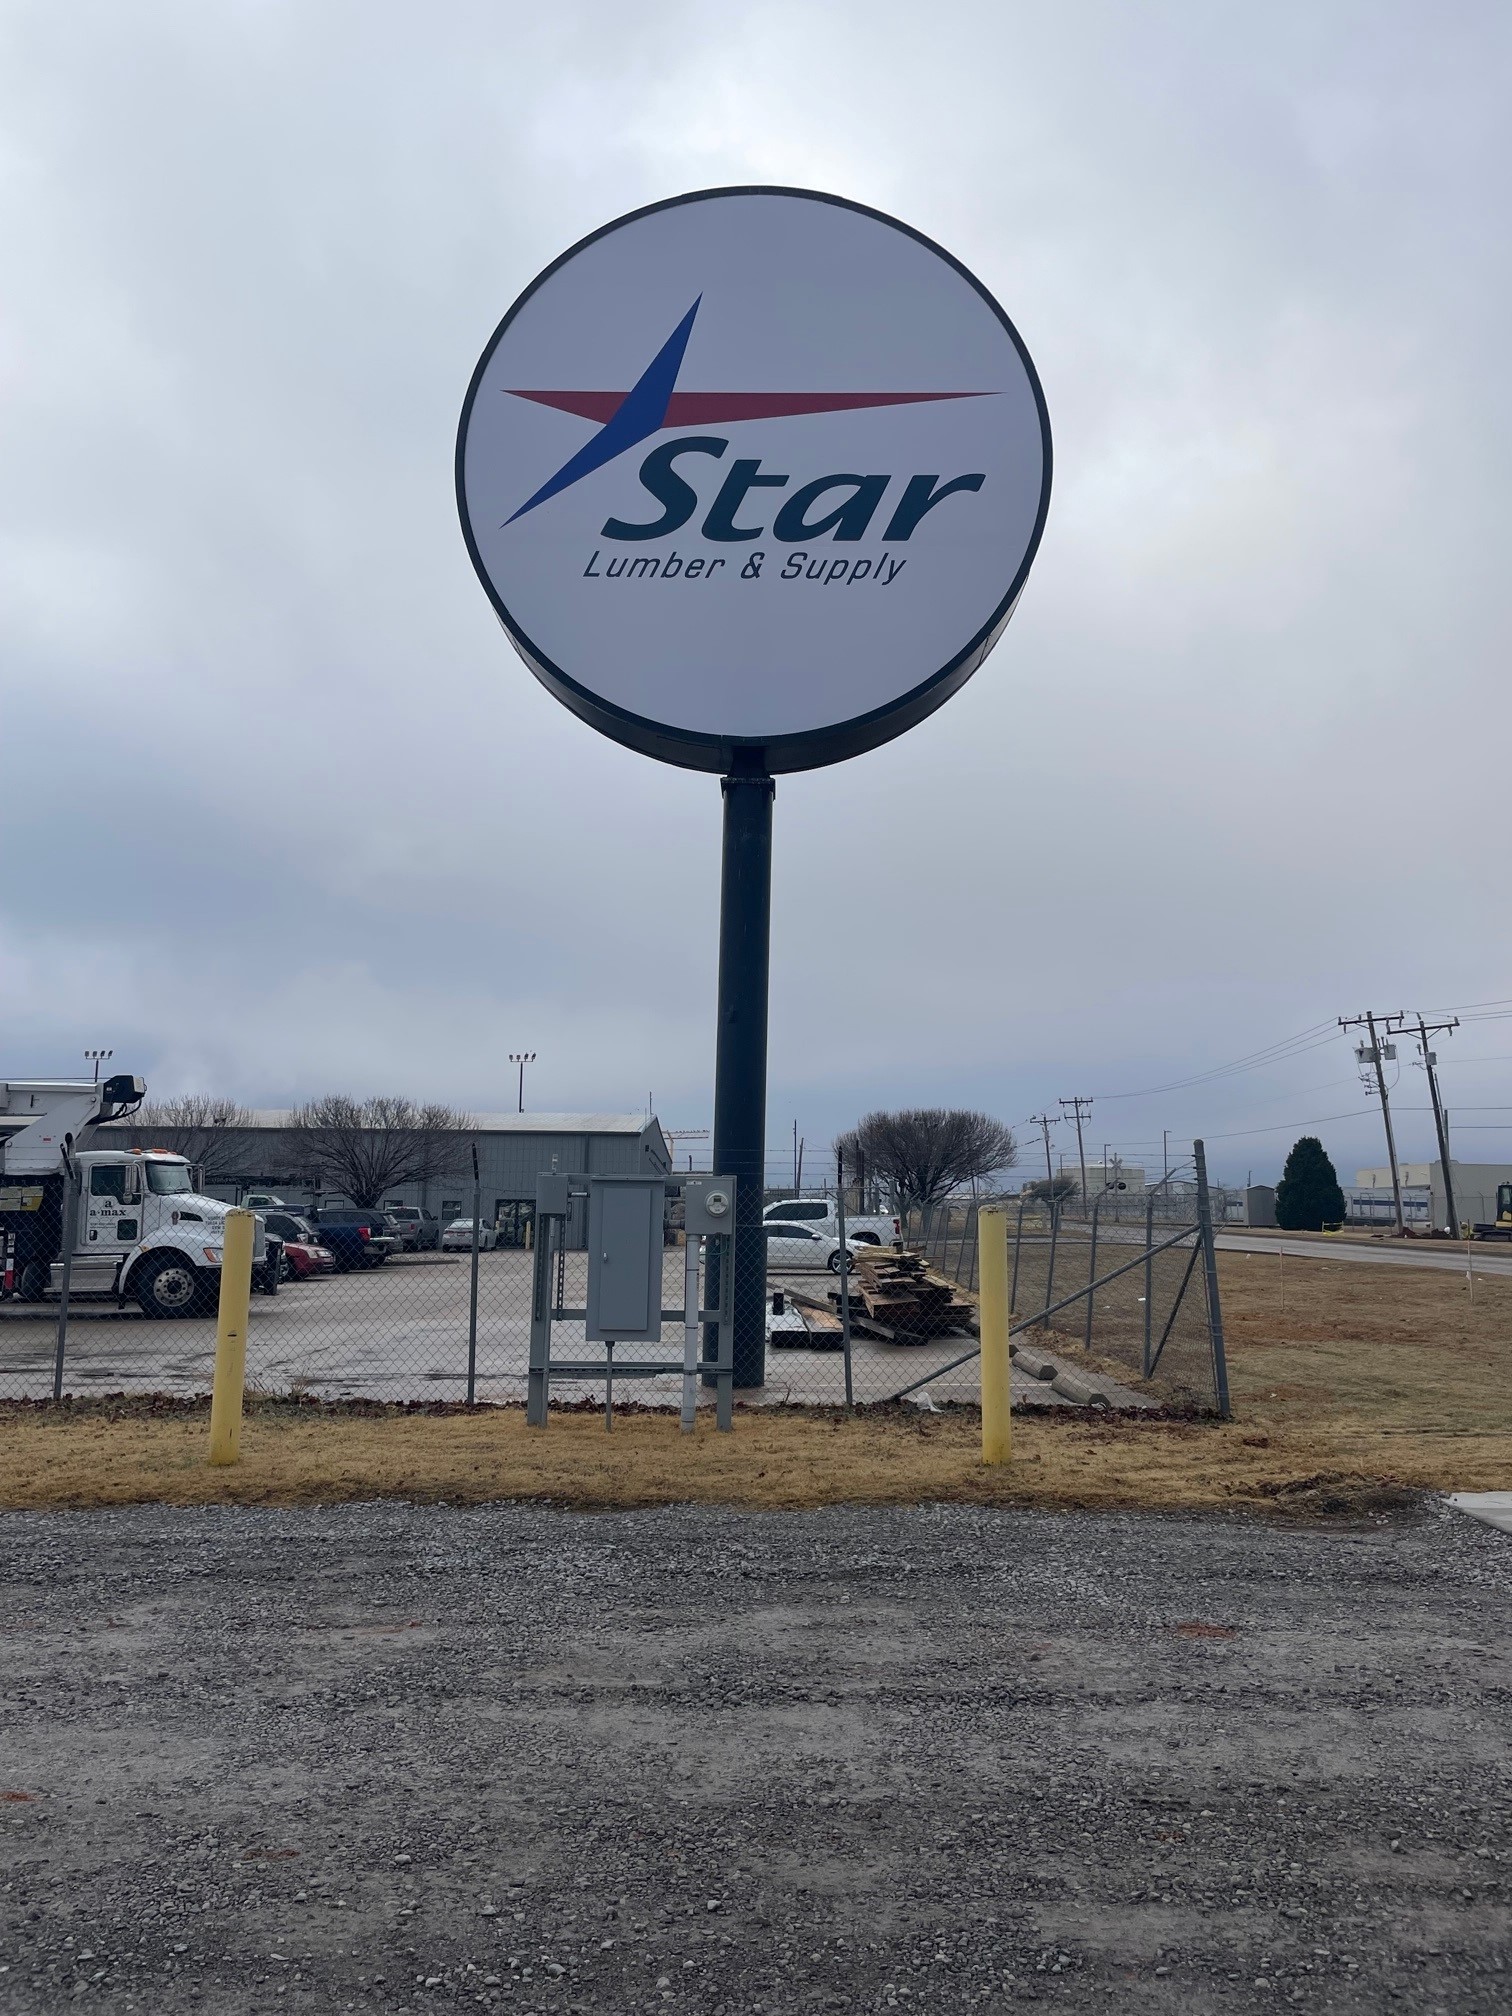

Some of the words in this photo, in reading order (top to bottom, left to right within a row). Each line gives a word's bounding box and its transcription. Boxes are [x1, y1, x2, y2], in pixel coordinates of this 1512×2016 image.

[600, 436, 987, 543] Star
[583, 550, 726, 579] Lumber
[740, 551, 766, 580] &
[780, 551, 908, 586] Supply
